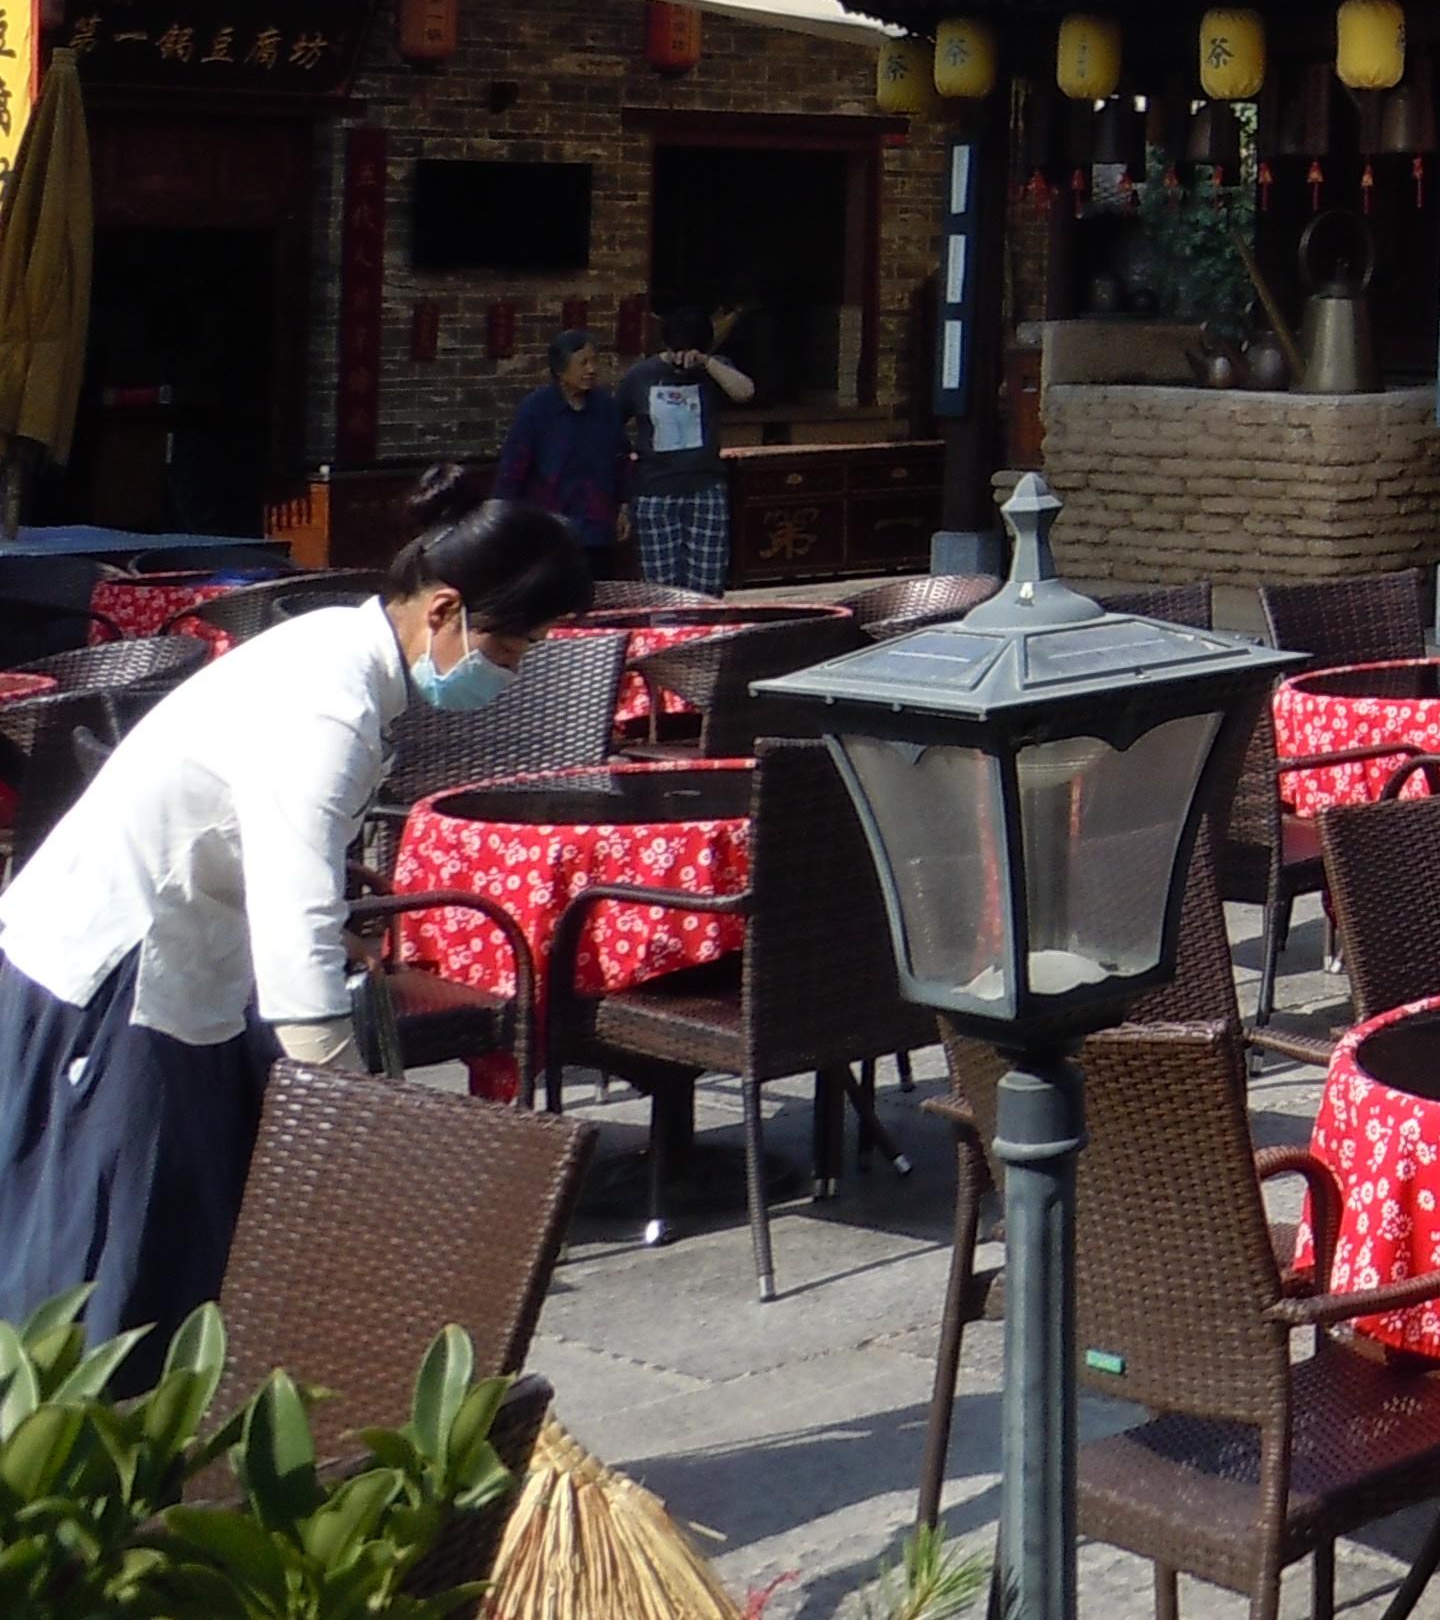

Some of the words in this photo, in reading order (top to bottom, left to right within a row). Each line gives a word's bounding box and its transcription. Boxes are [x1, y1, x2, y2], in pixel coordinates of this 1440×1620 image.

[943, 36, 970, 67] 茶
[1207, 37, 1234, 68] 茶
[883, 54, 909, 82] 茶
